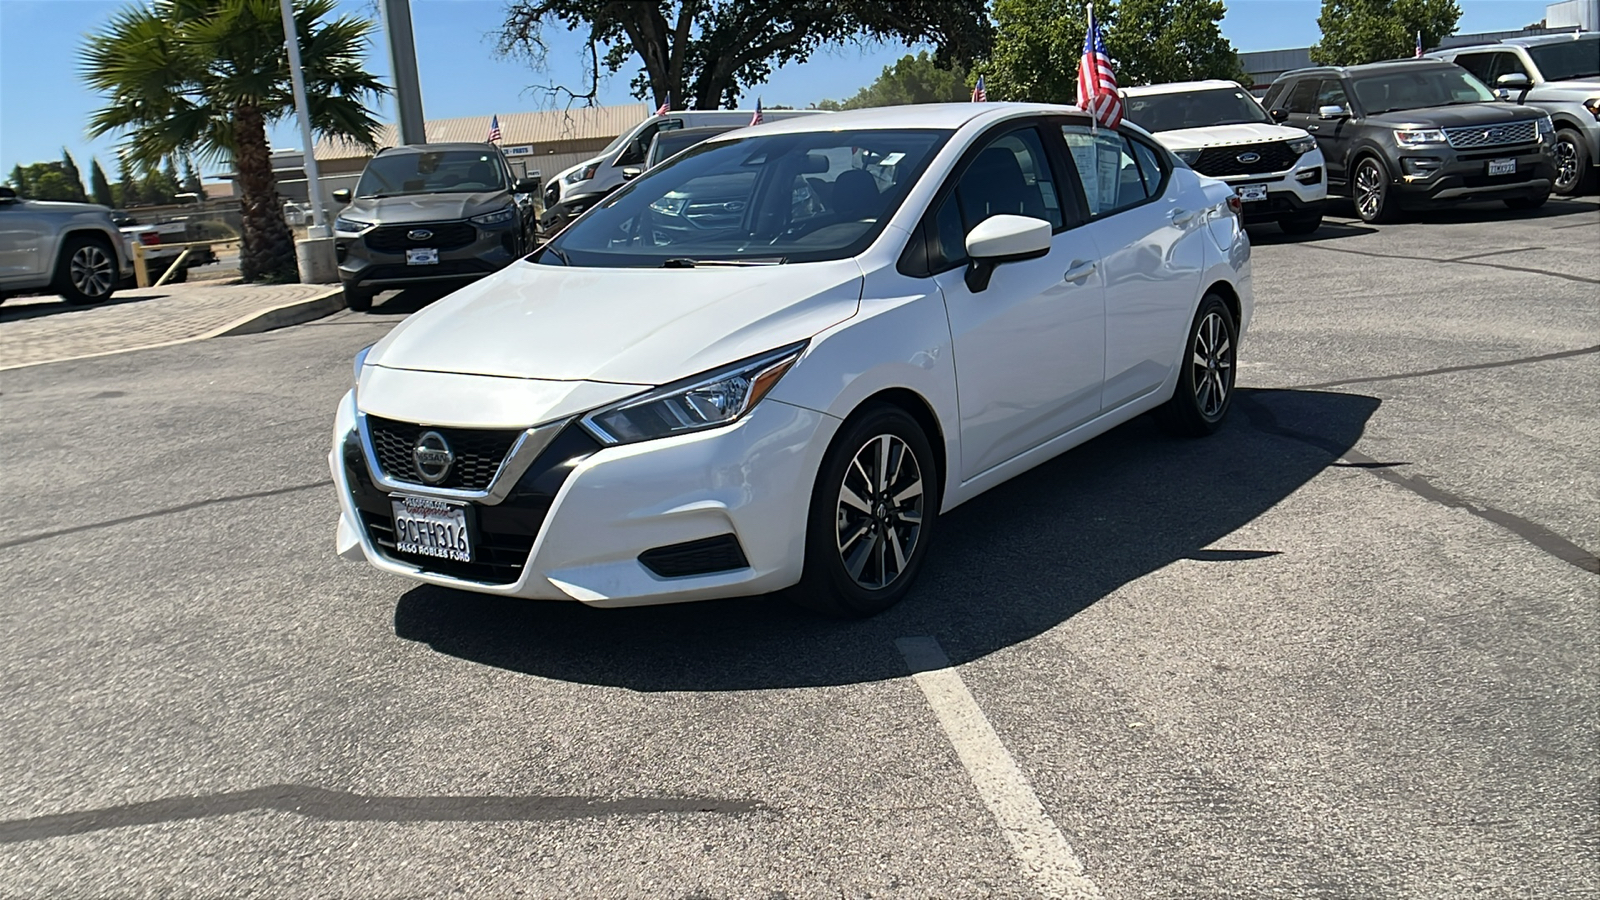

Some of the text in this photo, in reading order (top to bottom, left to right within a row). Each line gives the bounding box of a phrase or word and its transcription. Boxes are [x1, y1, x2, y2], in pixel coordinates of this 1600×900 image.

[416, 451, 447, 463] NISSAN
[397, 517, 466, 552] 9CFH316
[397, 542, 471, 562] PASO ROBLES FORD
